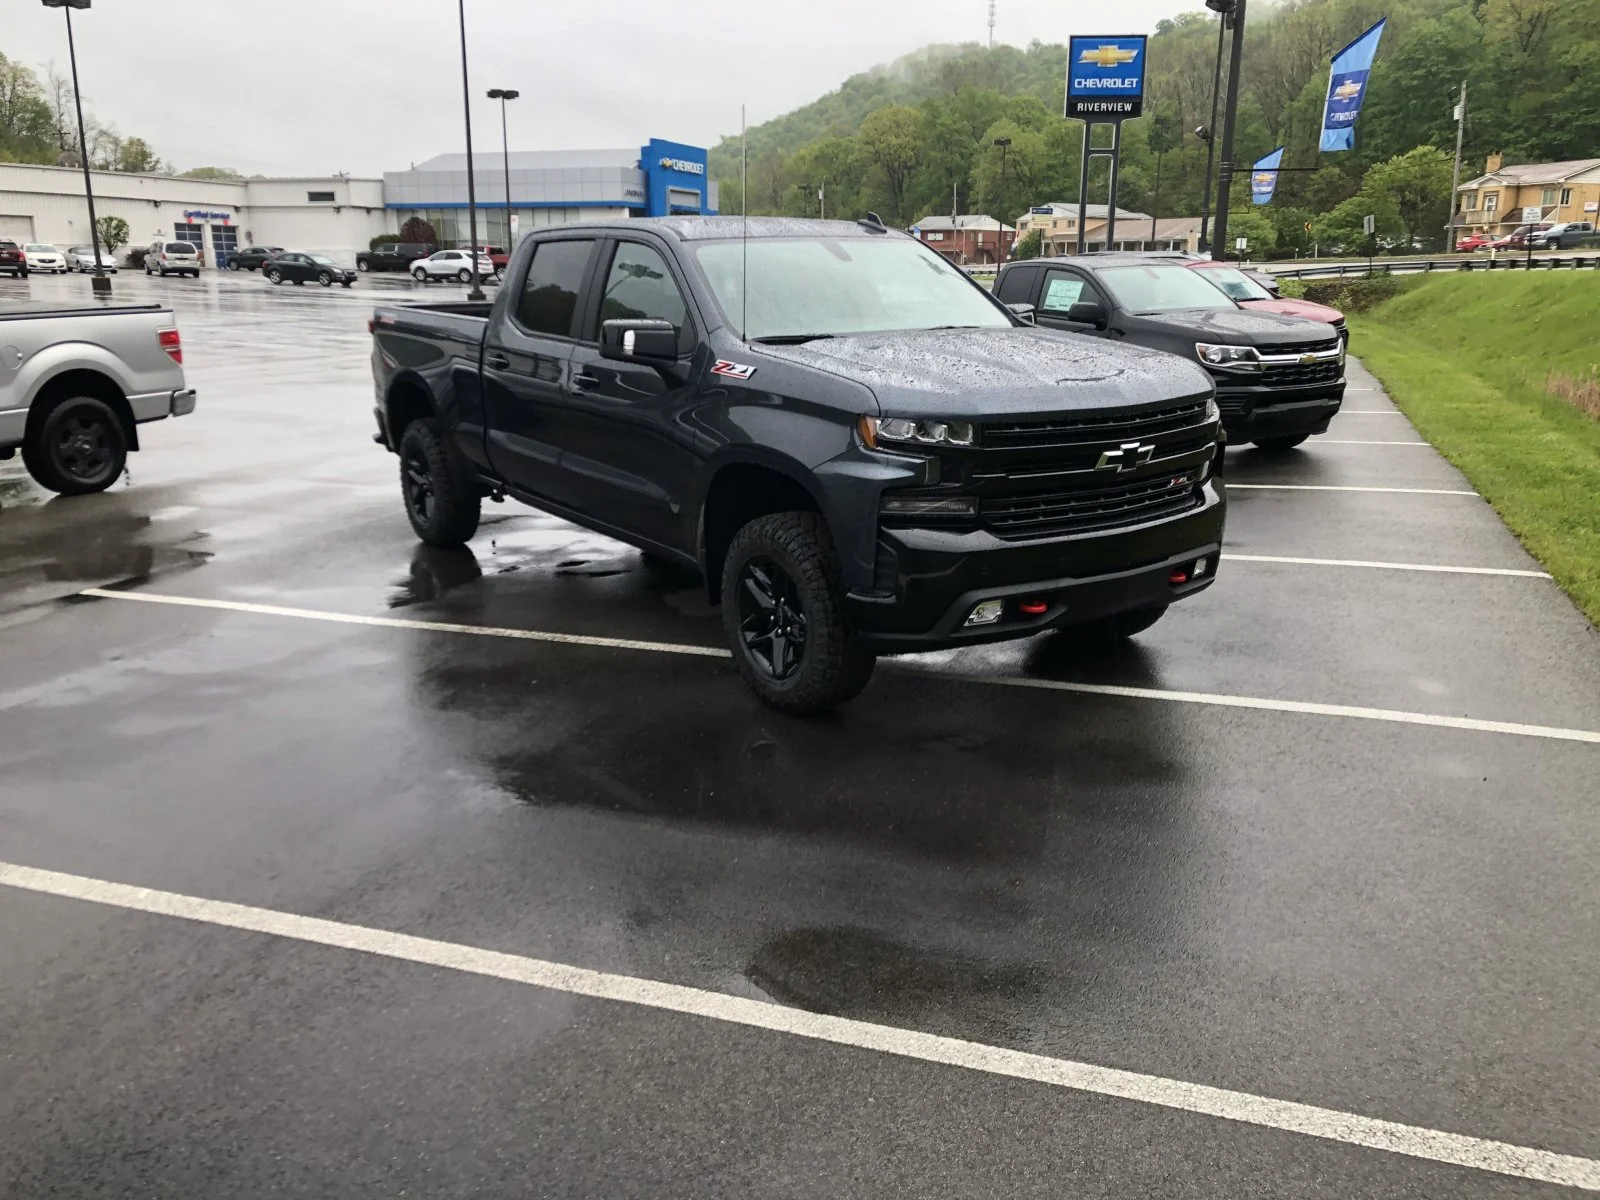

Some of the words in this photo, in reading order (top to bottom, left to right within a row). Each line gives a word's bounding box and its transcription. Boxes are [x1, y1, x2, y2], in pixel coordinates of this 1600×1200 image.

[1074, 78, 1138, 88] CHEVROLET
[1077, 102, 1133, 112] RIVERVIEW
[672, 158, 704, 174] CHEVROLET
[710, 359, 757, 380] Z71
